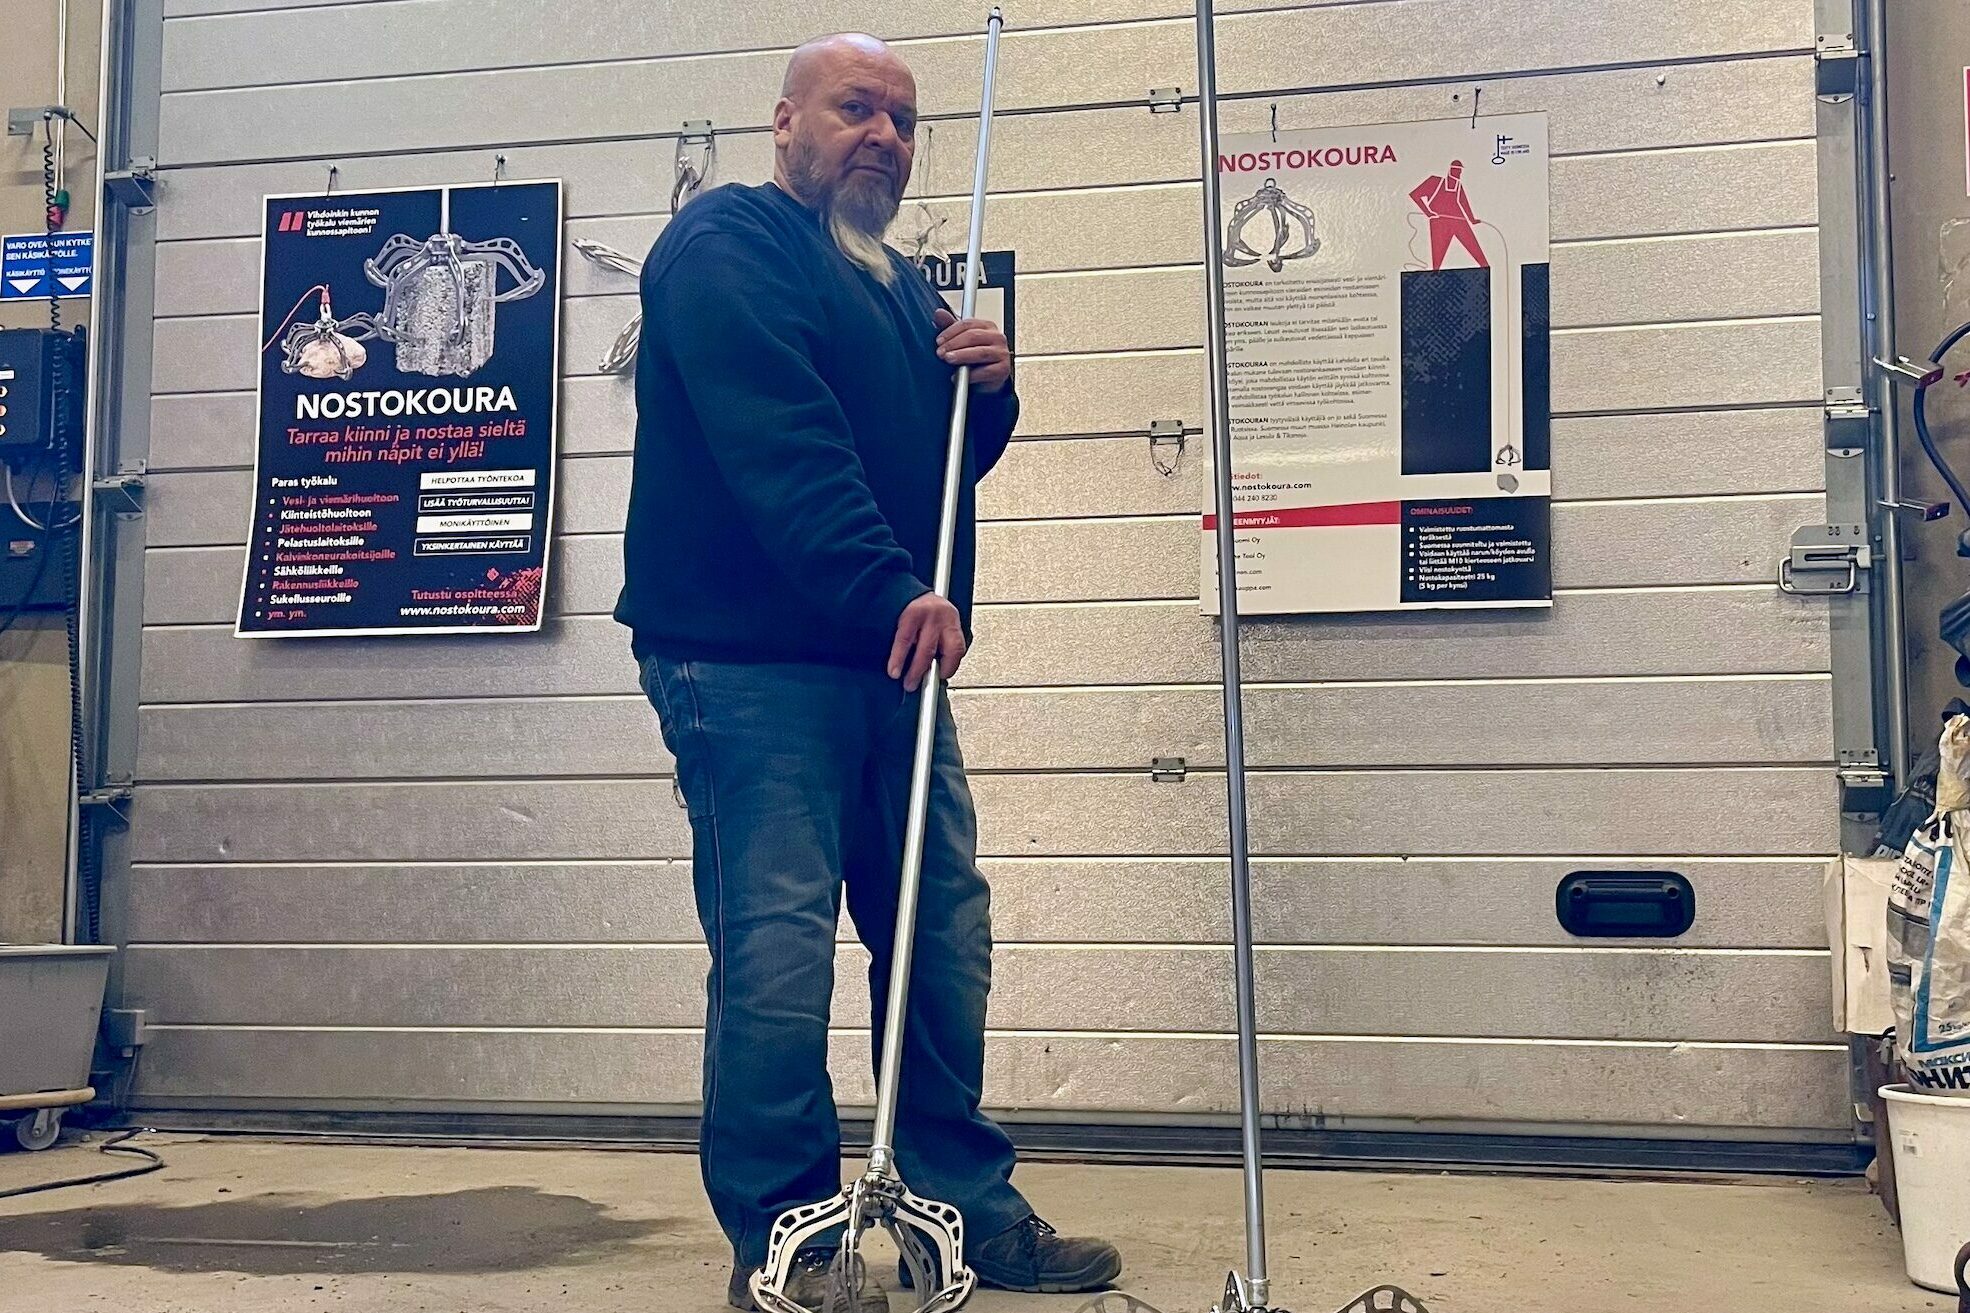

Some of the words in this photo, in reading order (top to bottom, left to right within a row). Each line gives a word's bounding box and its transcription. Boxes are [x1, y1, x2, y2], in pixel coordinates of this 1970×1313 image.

[1219, 145, 1397, 172] NOSTOKOURA
[307, 209, 349, 219] Vihdoinkin
[307, 219, 336, 229] työkalu
[338, 217, 376, 226] viemärien
[307, 226, 372, 237] kunnossapitoon!
[6, 242, 27, 250] VARO
[28, 241, 48, 249] OVEA
[66, 238, 93, 246] KYTKE
[6, 268, 45, 277] KÄSIKÄYTTÖ
[1224, 280, 1263, 289] OSTOKOURA
[1224, 320, 1268, 329] OSTOKOURAN
[1228, 361, 1268, 369] STOKOURAA
[297, 386, 518, 419] NOSTOKOURA
[287, 428, 339, 444] Tarraa
[344, 425, 392, 442] kiinni
[394, 425, 410, 446] ja
[415, 424, 473, 440] nostaa
[479, 419, 526, 437] sieltä
[325, 446, 372, 463] mihin
[378, 444, 423, 464] näpit
[428, 444, 443, 458] ei
[448, 442, 484, 463] yllä!
[432, 476, 475, 484] HELPOTTAA
[478, 475, 524, 483] TYÖNTEKOA
[1231, 472, 1262, 480] tiedot:
[272, 478, 299, 487] Paras
[301, 475, 338, 489] työkalu
[1232, 483, 1312, 491] w.nostokoura.com
[283, 496, 305, 506] Vesi-
[308, 496, 317, 507] ja
[320, 494, 399, 504] viemärihuoltoon
[424, 498, 446, 507] LISÄÄ
[448, 497, 530, 506] TYÖTURVALLISUUTTA!
[281, 508, 371, 520] Kiinteistöhuoltoon
[1234, 516, 1280, 525] EENMYYJÄT:
[280, 522, 378, 534] Jätehuoltolaitoksille
[278, 536, 364, 548] Pelastuslaitoksille
[422, 541, 488, 550] YKSINKERTAINEN
[489, 540, 523, 548] KÄYTTÄÄ
[1488, 541, 1495, 549] ja
[1446, 549, 1470, 557] käyttää
[274, 565, 343, 576] Sähköliikkeille
[1434, 566, 1471, 574] nostokynttä
[272, 579, 359, 590] Rakennusliikkeille
[1427, 582, 1435, 590] kg
[270, 593, 352, 604] Sukellusseuroille
[412, 590, 452, 600] Tutustu
[455, 589, 518, 599] osoitteessa
[268, 612, 285, 620] ym.
[289, 611, 306, 620] ym.
[400, 604, 525, 616] www.nostokoura.com
